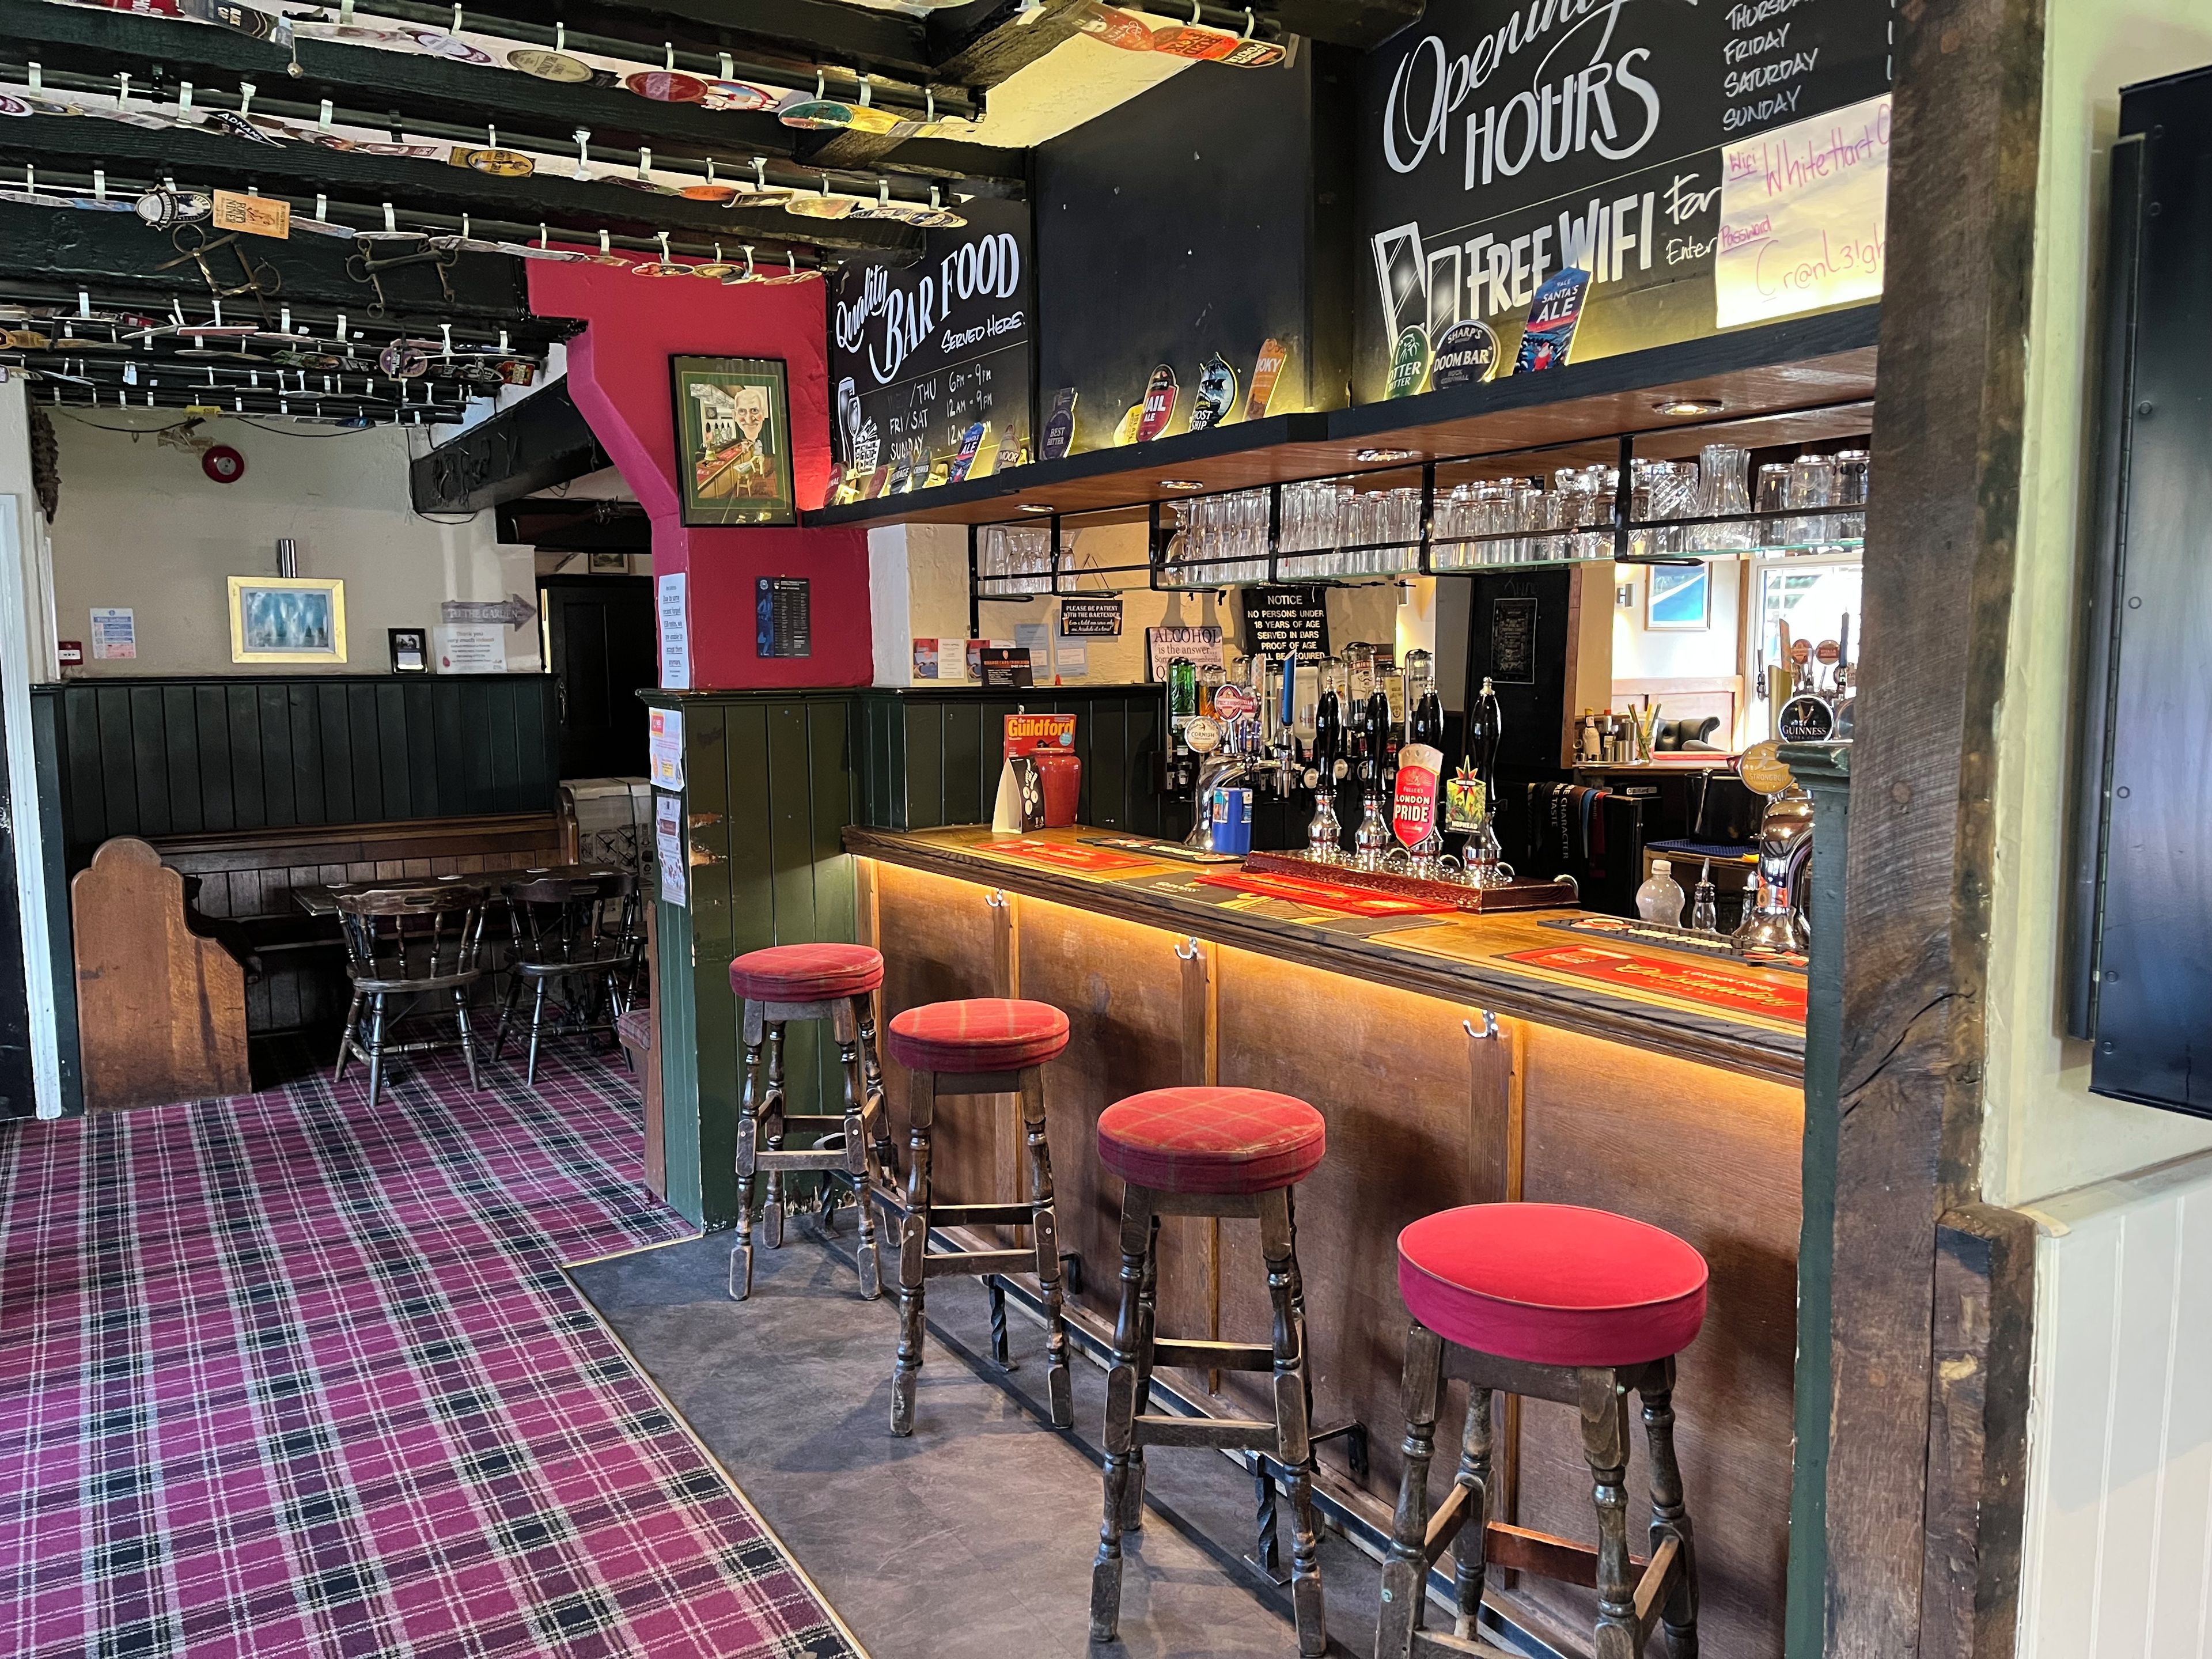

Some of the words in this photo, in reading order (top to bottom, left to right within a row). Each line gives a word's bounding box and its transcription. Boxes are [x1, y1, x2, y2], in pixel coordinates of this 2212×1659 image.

[1725, 0, 1813, 31] THURSD
[1724, 22, 1790, 65] FRIDAY
[1724, 47, 1819, 98] SATURDAY
[1723, 85, 1801, 131] SUNDAY
[218, 112, 263, 141] ADNAMS
[1464, 47, 1660, 191] HOURS
[1719, 214, 1772, 248] Password
[1465, 224, 1552, 320] FREE
[1559, 191, 1655, 285] WIFI
[1665, 236, 1718, 266] Enter
[1541, 285, 1580, 304] SANTA'S
[836, 264, 888, 353] Quality
[869, 275, 935, 384] BAR
[940, 233, 1020, 321] FOOD
[1536, 296, 1577, 324] ALE
[941, 326, 985, 353] SERVED
[1447, 327, 1483, 344] SHARP'S
[1433, 351, 1464, 373] DOOM
[1464, 349, 1490, 366] BAR
[1050, 426, 1066, 437] BEST
[890, 433, 924, 461] SUNDAY
[961, 441, 976, 455] ALE
[1047, 437, 1064, 446] BITTER
[1267, 595, 1303, 605] NOTICE
[461, 609, 481, 618] THE
[482, 608, 518, 619] GARDEN
[1247, 610, 1259, 618] NO
[1262, 609, 1297, 618] PERSONS
[1300, 609, 1324, 618] UNDER
[1254, 621, 1263, 629] 18
[1265, 620, 1290, 629] YEARS
[1293, 620, 1303, 628] OF
[1305, 620, 1320, 628] AGE
[1154, 628, 1221, 643] ALCOHOL
[1257, 631, 1287, 639] SERVED
[1289, 631, 1297, 639] IN
[1300, 631, 1319, 639] BARS
[1158, 645, 1165, 654] is
[1167, 644, 1180, 654] the
[1261, 642, 1287, 650] PROOF
[1289, 642, 1300, 650] OF
[1275, 652, 1286, 661] BE
[1294, 652, 1325, 660] EQUIRED
[1008, 719, 1074, 737] Guildford
[1782, 725, 1827, 736] GUINNESS
[1396, 794, 1431, 805] LONDON
[1395, 805, 1429, 823] PRIDE
[1560, 797, 1569, 859] CHARACTER
